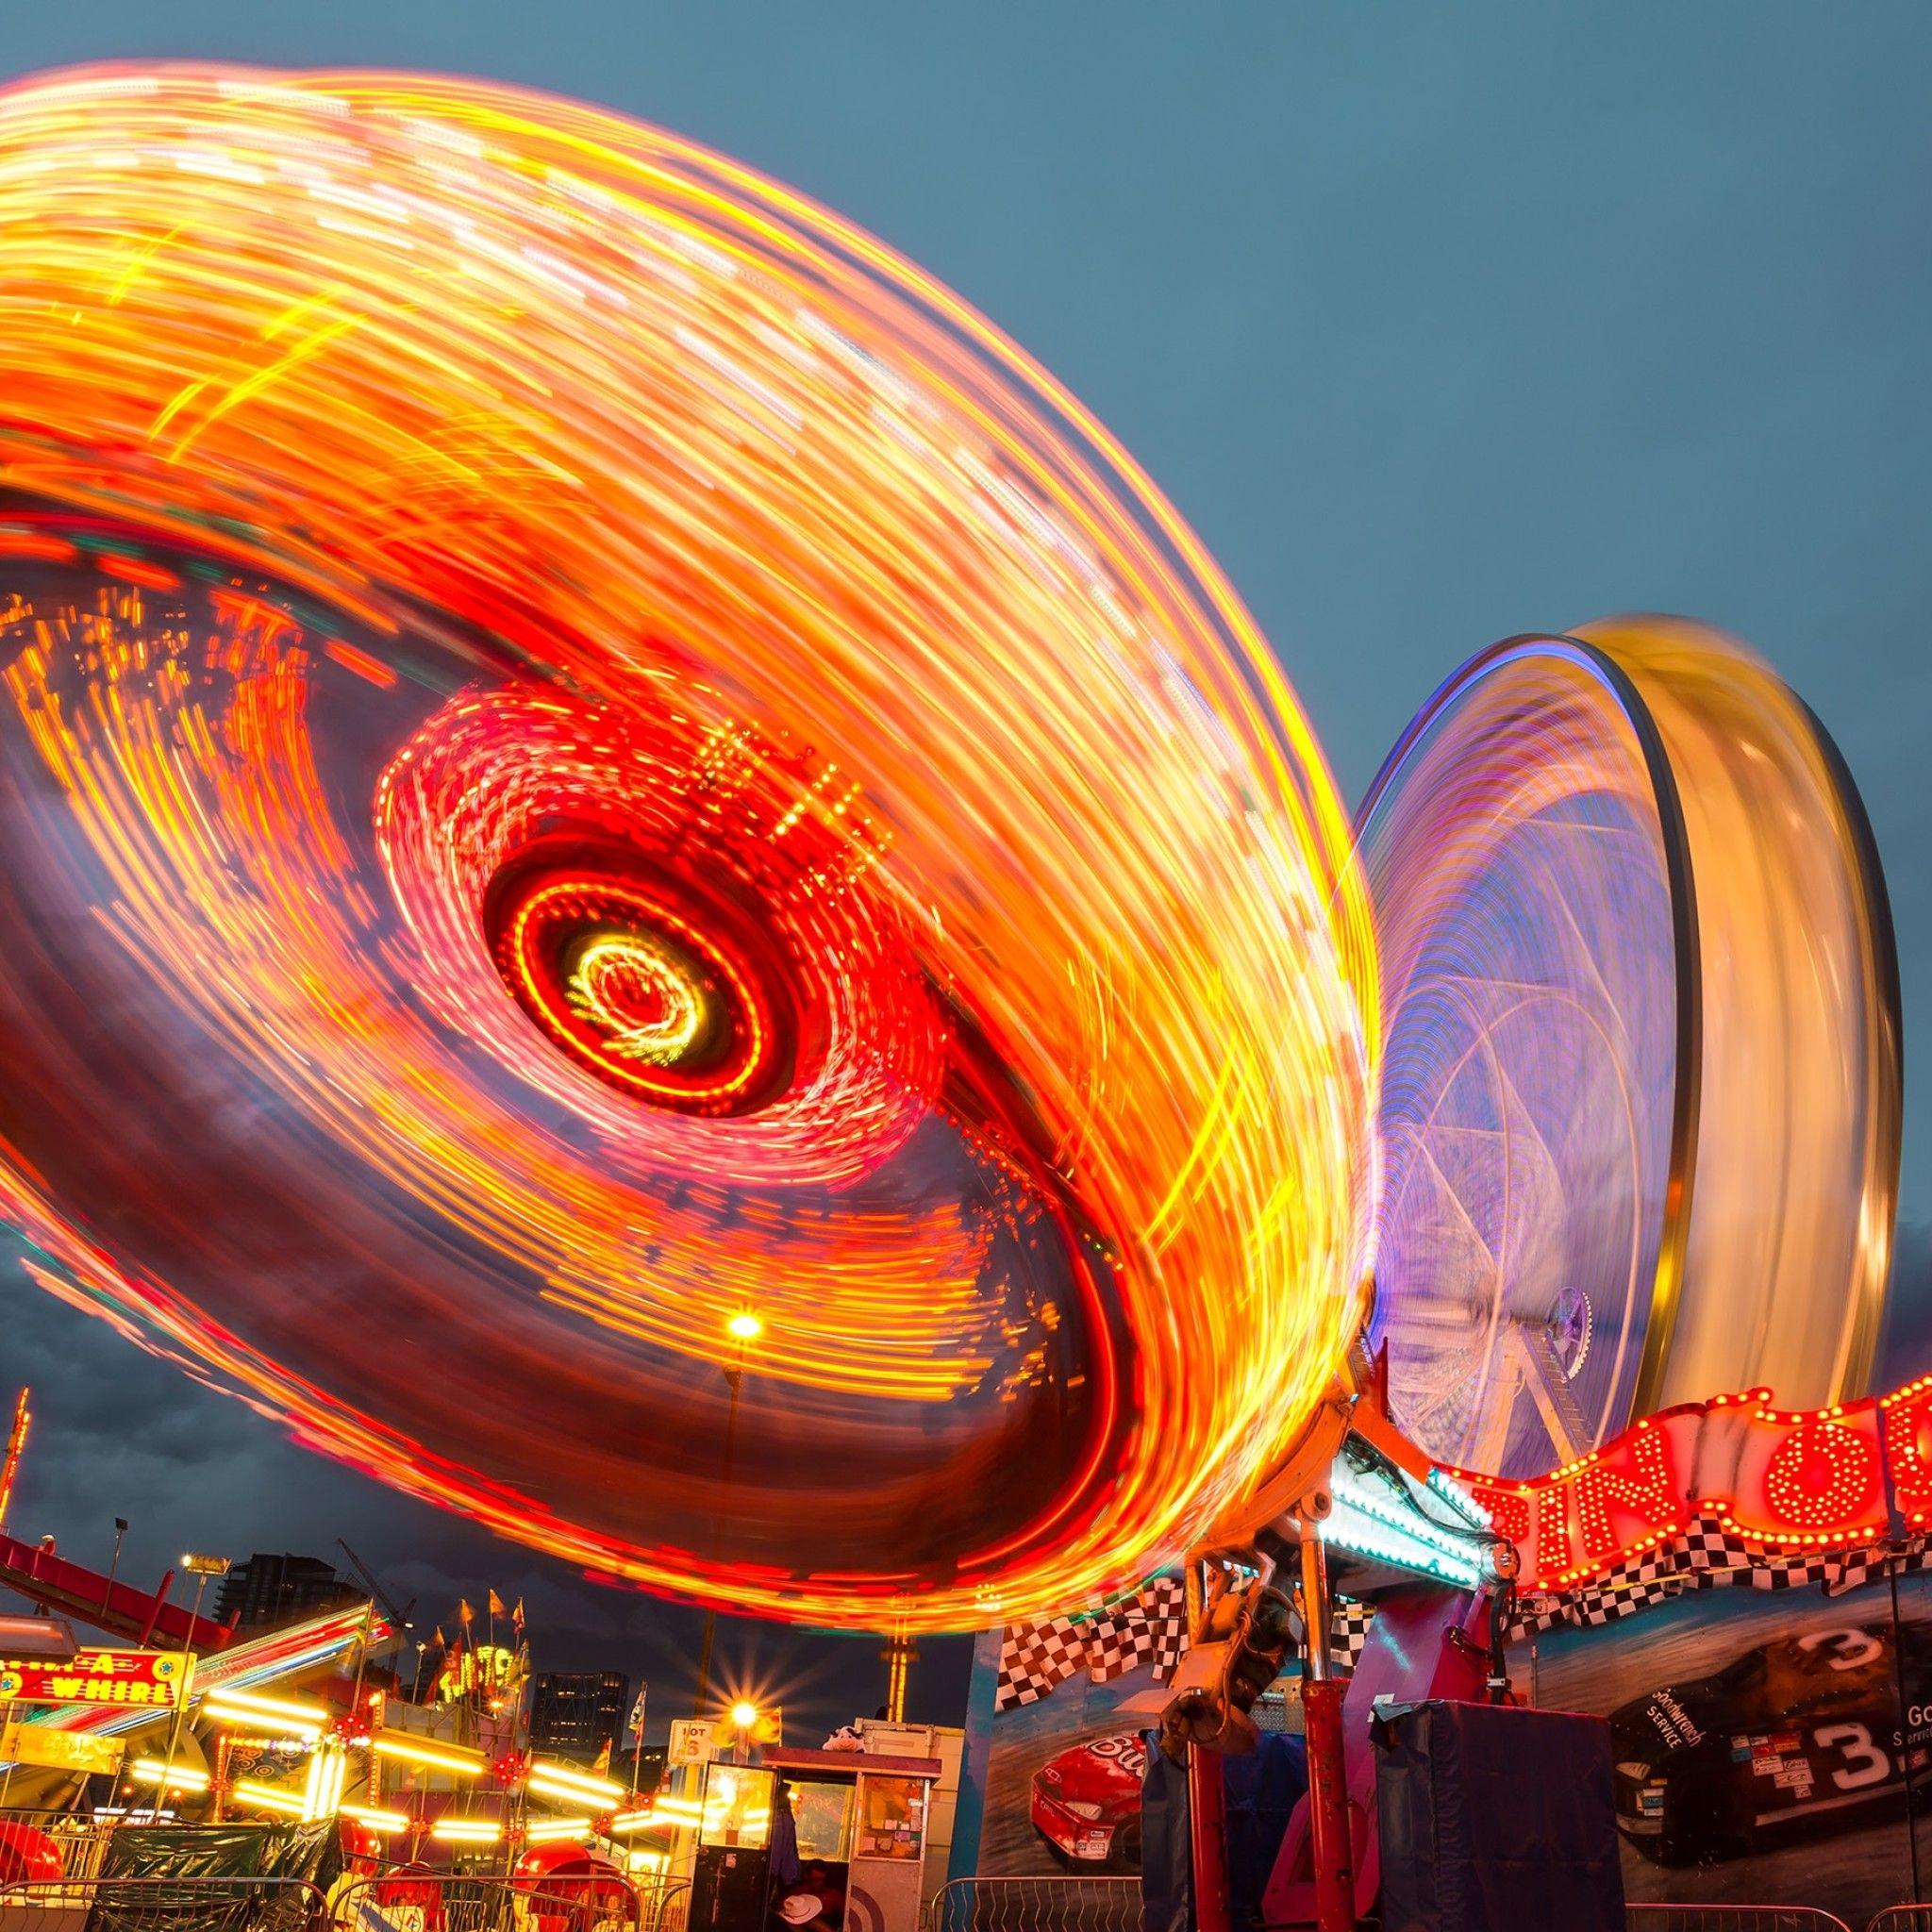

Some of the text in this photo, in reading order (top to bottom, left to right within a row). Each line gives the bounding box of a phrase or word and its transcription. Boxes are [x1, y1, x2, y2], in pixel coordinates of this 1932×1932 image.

[1798, 1628, 1883, 1671] 3
[52, 1677, 170, 1704] WHIRL
[1646, 1706, 1683, 1749] SERVICE
[1813, 1723, 1890, 1790] 3
